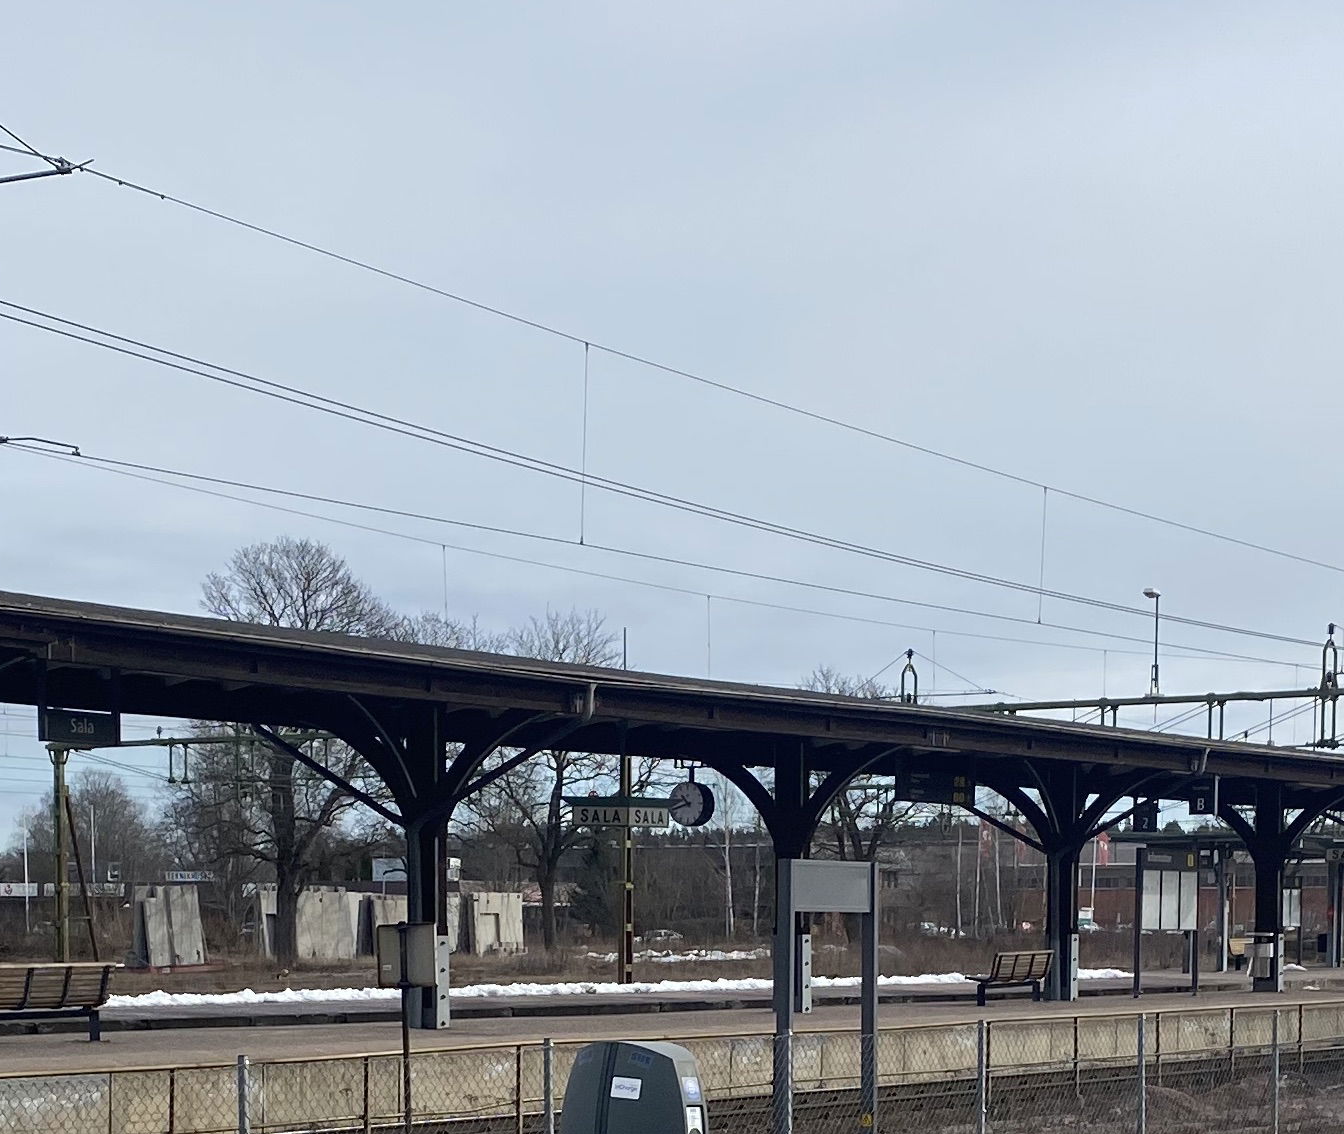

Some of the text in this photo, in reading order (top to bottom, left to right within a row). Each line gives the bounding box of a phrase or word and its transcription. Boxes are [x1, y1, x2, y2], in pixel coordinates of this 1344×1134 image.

[70, 718, 95, 734] Sala
[1197, 798, 1205, 811] B
[580, 808, 665, 825] SALA SALA
[1142, 817, 1149, 829] 2
